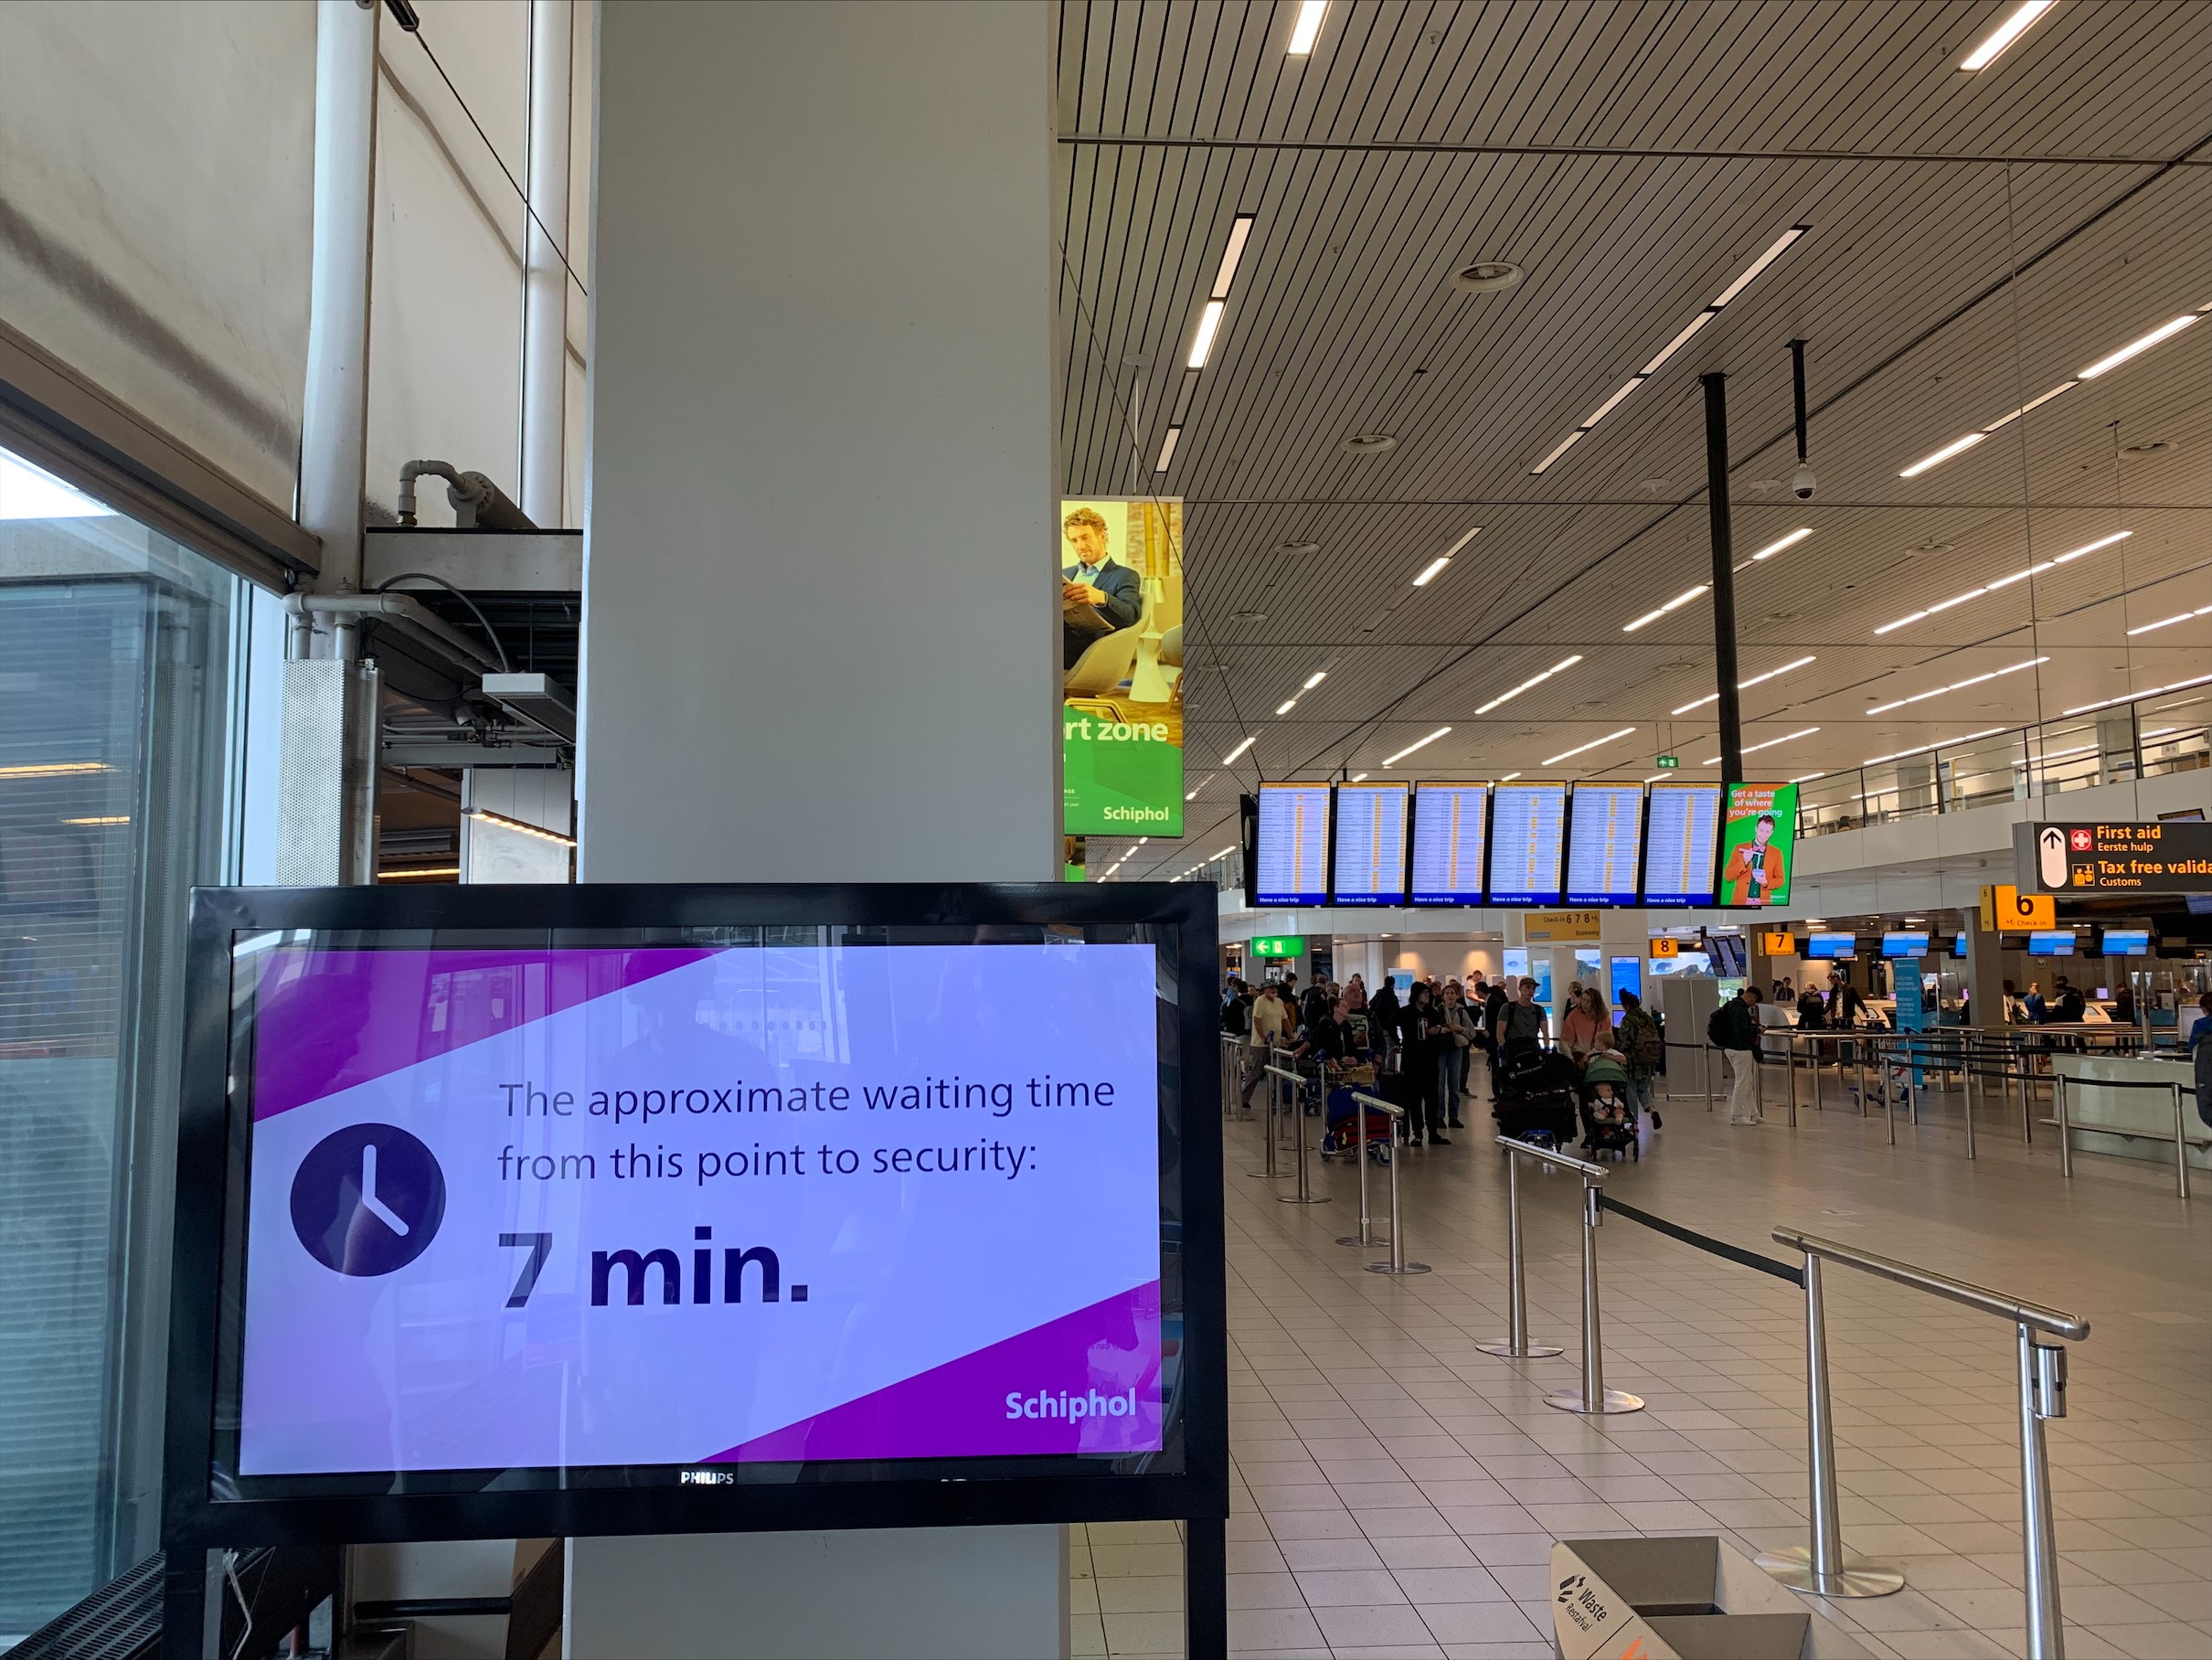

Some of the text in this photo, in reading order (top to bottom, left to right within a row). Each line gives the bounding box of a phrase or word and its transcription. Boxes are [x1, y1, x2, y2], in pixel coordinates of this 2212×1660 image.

[1064, 718, 1169, 742] rt zone
[1103, 806, 1169, 824] Schiphol
[1729, 808, 1782, 817] you're going
[2097, 825, 2161, 839] First aid
[2098, 842, 2154, 853] Eerste hulp
[2098, 861, 2126, 874] Tax
[2130, 859, 2163, 874] free
[2099, 877, 2142, 886] Customs
[2016, 896, 2034, 916] 6
[1566, 914, 1572, 924] 6
[1575, 914, 1580, 923] 7
[1584, 914, 1590, 923] 8
[1661, 940, 1669, 952] 8
[1775, 934, 1785, 948] 7
[499, 1074, 1116, 1124] The approximate waiting time
[497, 1138, 1037, 1186] from this point to security:
[498, 1225, 809, 1309] 7 min.
[1005, 1387, 1136, 1424] Schiphol
[680, 1472, 734, 1484] PHILIPS
[1578, 1587, 1607, 1622] Waste
[1565, 1602, 1593, 1633] Restafval
